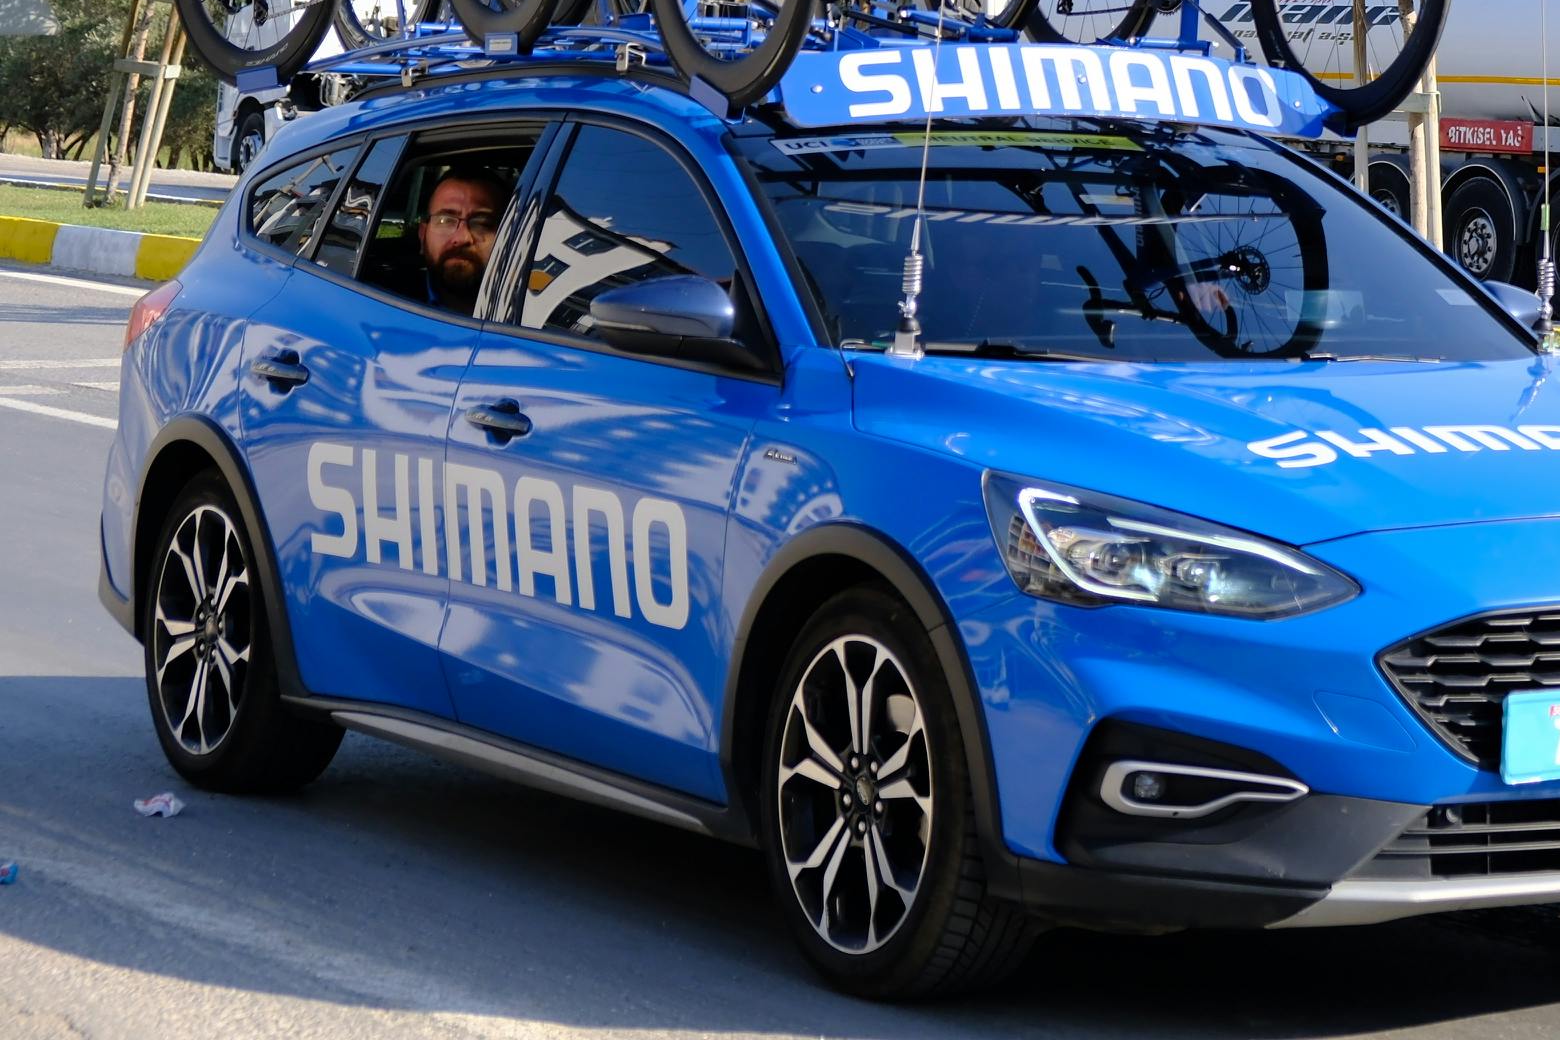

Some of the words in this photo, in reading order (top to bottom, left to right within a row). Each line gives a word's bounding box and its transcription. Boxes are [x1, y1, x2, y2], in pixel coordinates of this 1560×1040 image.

[838, 46, 1283, 128] SHIMANO
[785, 140, 829, 150] UCI
[307, 442, 690, 630] SHIMANO
